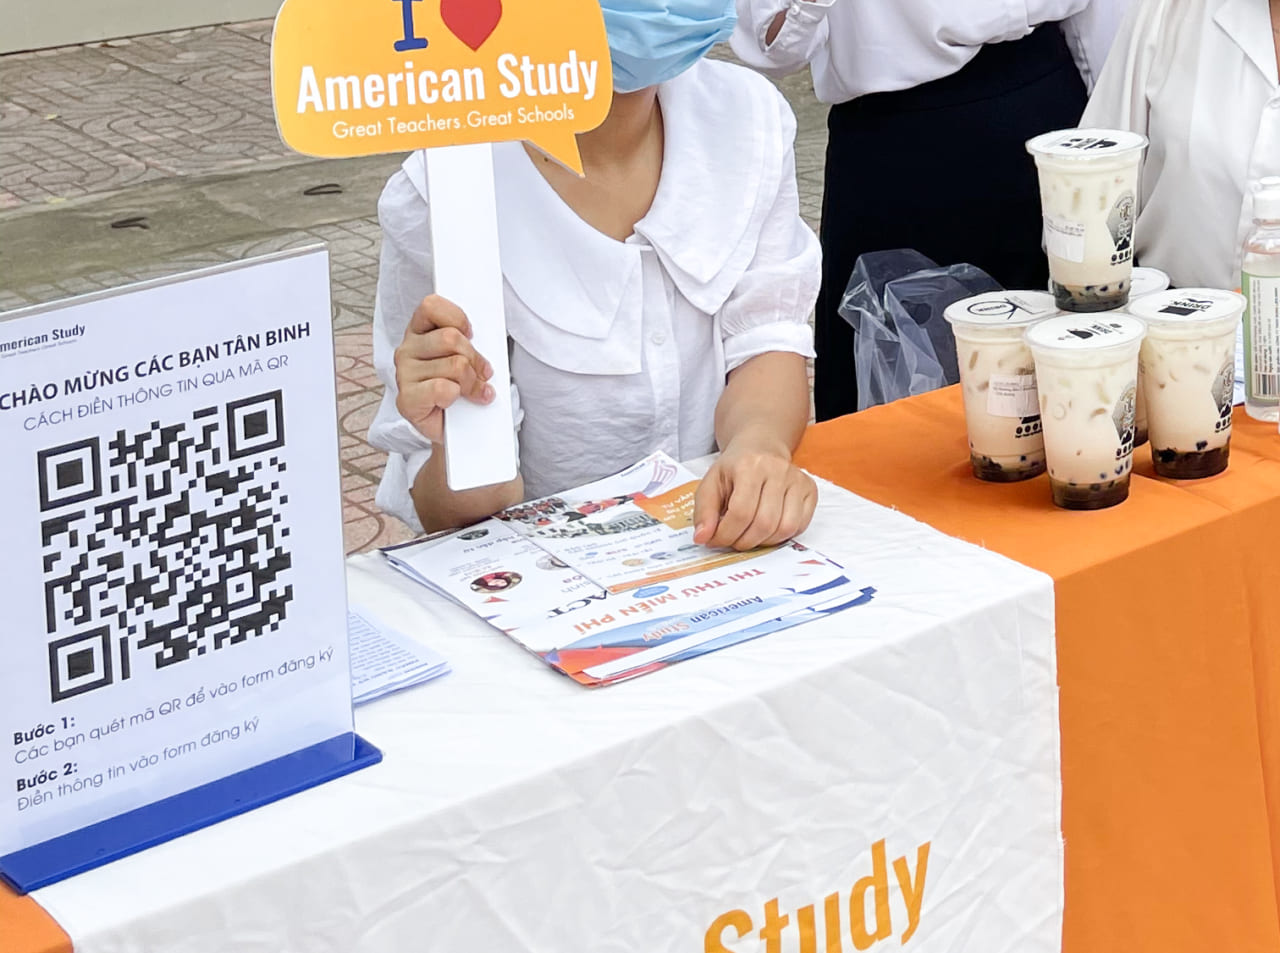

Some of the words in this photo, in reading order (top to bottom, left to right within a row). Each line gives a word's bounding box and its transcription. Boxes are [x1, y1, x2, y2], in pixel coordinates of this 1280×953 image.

[297, 61, 486, 114] American
[496, 49, 599, 101] Study
[332, 119, 382, 139] Great
[518, 104, 575, 125] Schools
[0, 334, 48, 352] merican
[52, 324, 85, 340] Study
[0, 383, 58, 410] CHÀO
[64, 365, 129, 396] MỪNG
[134, 353, 174, 379] CÁC
[178, 344, 220, 370] BẠN
[223, 334, 261, 360] TÂN
[265, 322, 311, 347] BINH
[23, 410, 73, 432] CÁCH
[117, 383, 173, 409] THÔNG
[177, 377, 199, 393] TIN
[202, 368, 235, 388] QUA
[239, 357, 264, 379] MÃ
[267, 354, 289, 371] QR
[727, 568, 766, 583] THI
[573, 614, 616, 636] PHÍ
[690, 596, 763, 624] American
[642, 621, 690, 642] Study
[14, 745, 50, 765] Các
[53, 732, 86, 754] bạn
[89, 716, 126, 742] quét
[129, 706, 155, 726] mã
[158, 697, 182, 717] QR
[185, 686, 207, 708] để
[209, 680, 238, 700] vào
[241, 668, 275, 689] form
[277, 657, 316, 680] đăng
[318, 647, 335, 664] ký
[13, 721, 56, 746] Bước
[60, 715, 77, 730] 1:
[16, 768, 59, 792] Bước
[63, 761, 79, 776] 2:
[17, 788, 54, 811] Điền
[57, 769, 104, 798] thông
[107, 763, 126, 779] tin
[128, 751, 159, 770] vào
[163, 739, 198, 761] form
[200, 726, 240, 749] đăng
[243, 716, 261, 733] ký
